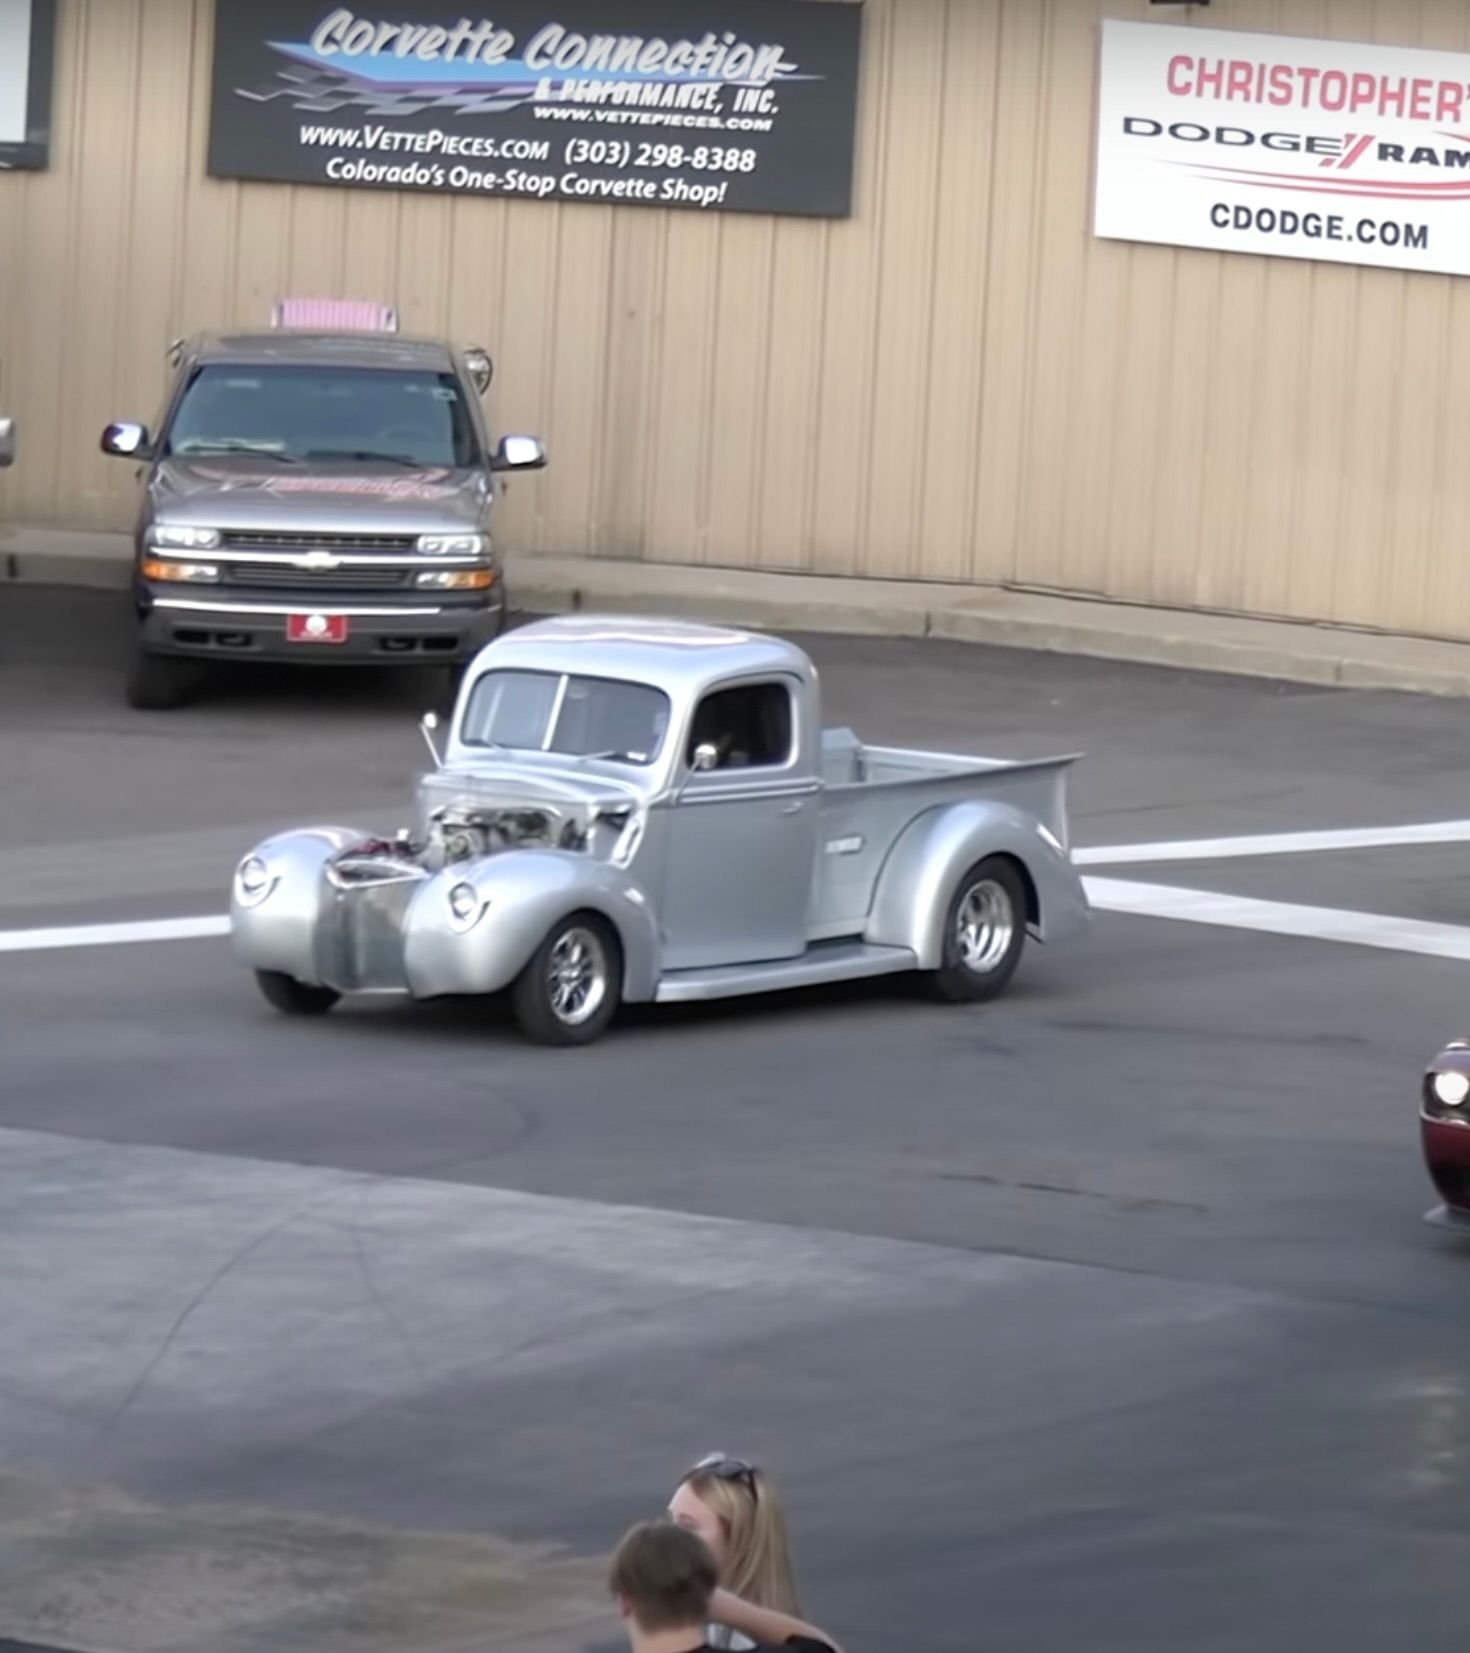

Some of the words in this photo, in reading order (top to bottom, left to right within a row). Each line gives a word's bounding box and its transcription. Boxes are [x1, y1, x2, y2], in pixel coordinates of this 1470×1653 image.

[310, 8, 515, 66] Corvette
[523, 22, 798, 82] Connection
[534, 77, 552, 101] &
[559, 79, 724, 114] PERFORMANCE,
[732, 88, 780, 114] INC.
[533, 106, 774, 131] WWW.VETTEPIECES.COM
[1122, 116, 1344, 157] DODGE
[564, 138, 630, 168] (303)
[634, 142, 757, 173] 298-8388
[326, 157, 445, 186] Colorado's
[449, 165, 556, 197] One-Stop
[560, 172, 657, 198] Corvette
[660, 178, 729, 206] Shop!
[1210, 202, 1429, 250] CDODGE.COM
